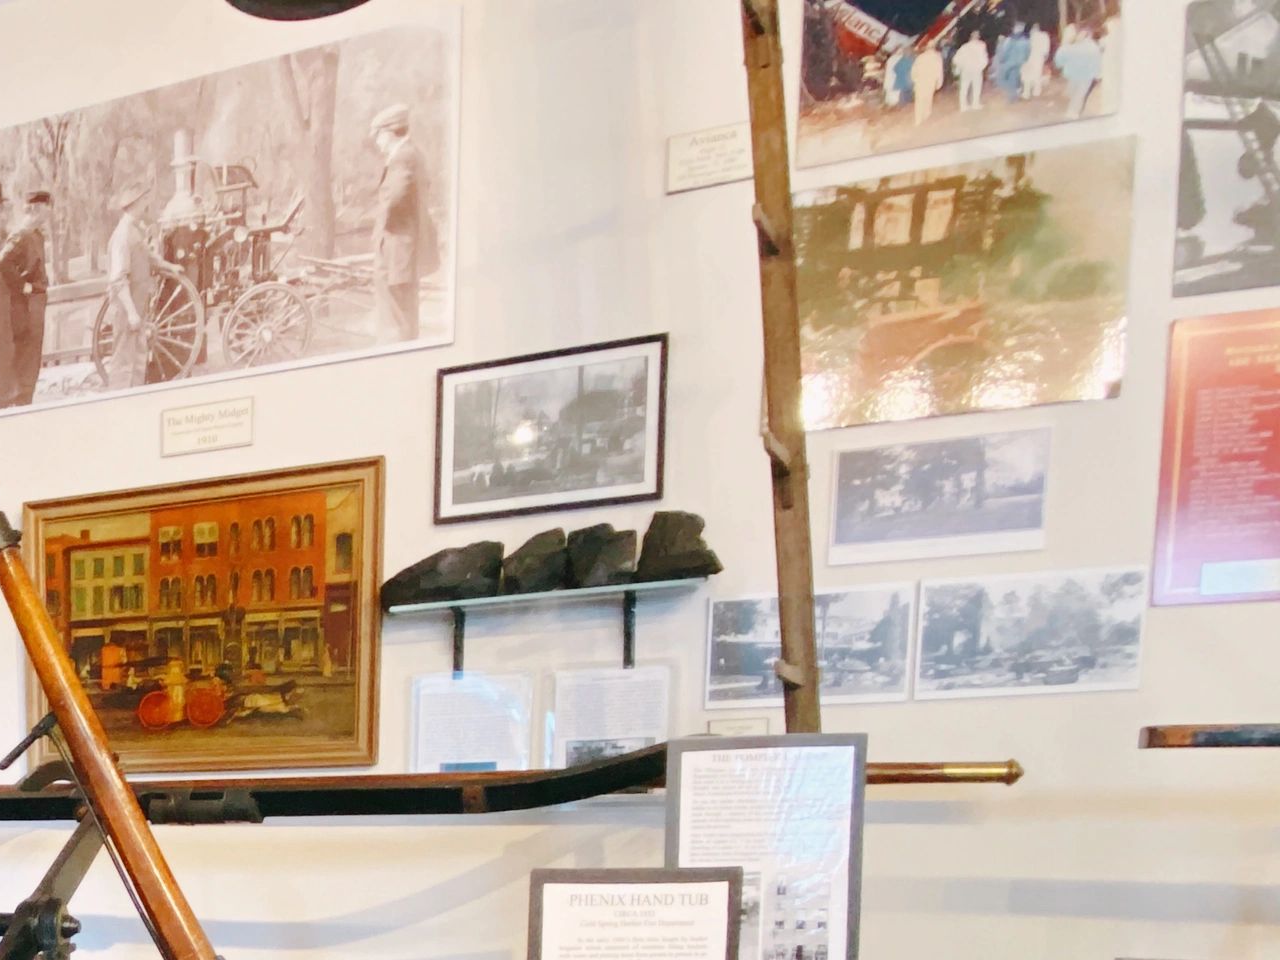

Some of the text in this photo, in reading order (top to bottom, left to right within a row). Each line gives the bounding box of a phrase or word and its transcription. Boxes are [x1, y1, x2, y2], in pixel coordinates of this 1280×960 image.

[218, 408, 249, 419] Midget
[569, 893, 709, 907] PHENIX HAND TUB
